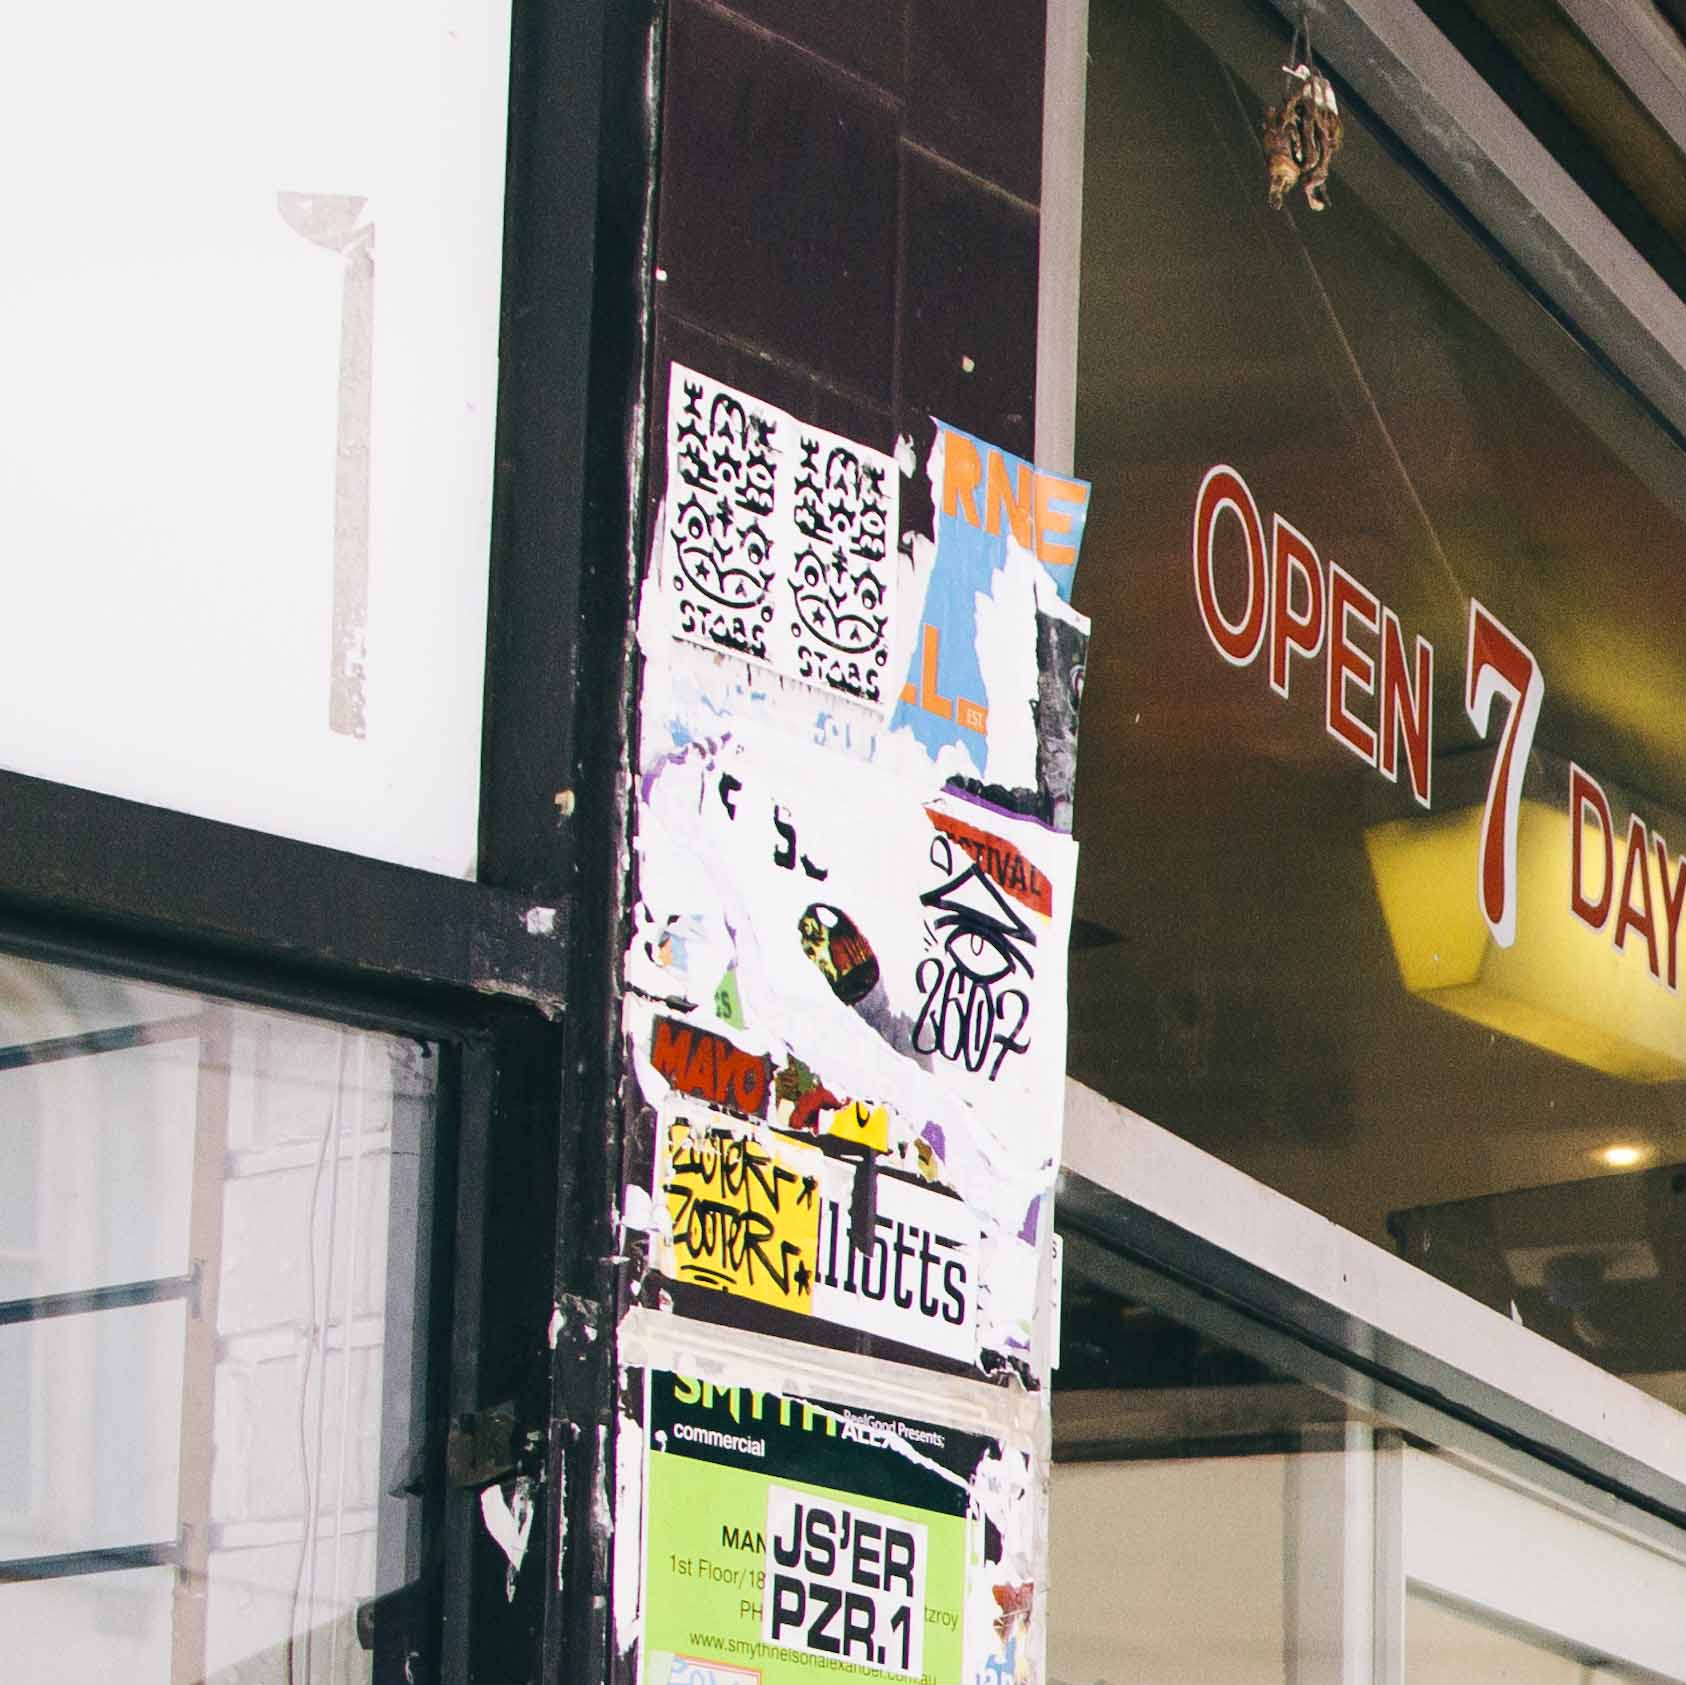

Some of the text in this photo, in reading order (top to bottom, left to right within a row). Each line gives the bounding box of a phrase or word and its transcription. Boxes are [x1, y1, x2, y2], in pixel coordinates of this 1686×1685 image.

[1193, 463, 1434, 810] OPEN
[1465, 596, 1546, 949] 7
[672, 1421, 766, 1457] commercial
[669, 1554, 693, 1578] 1st
